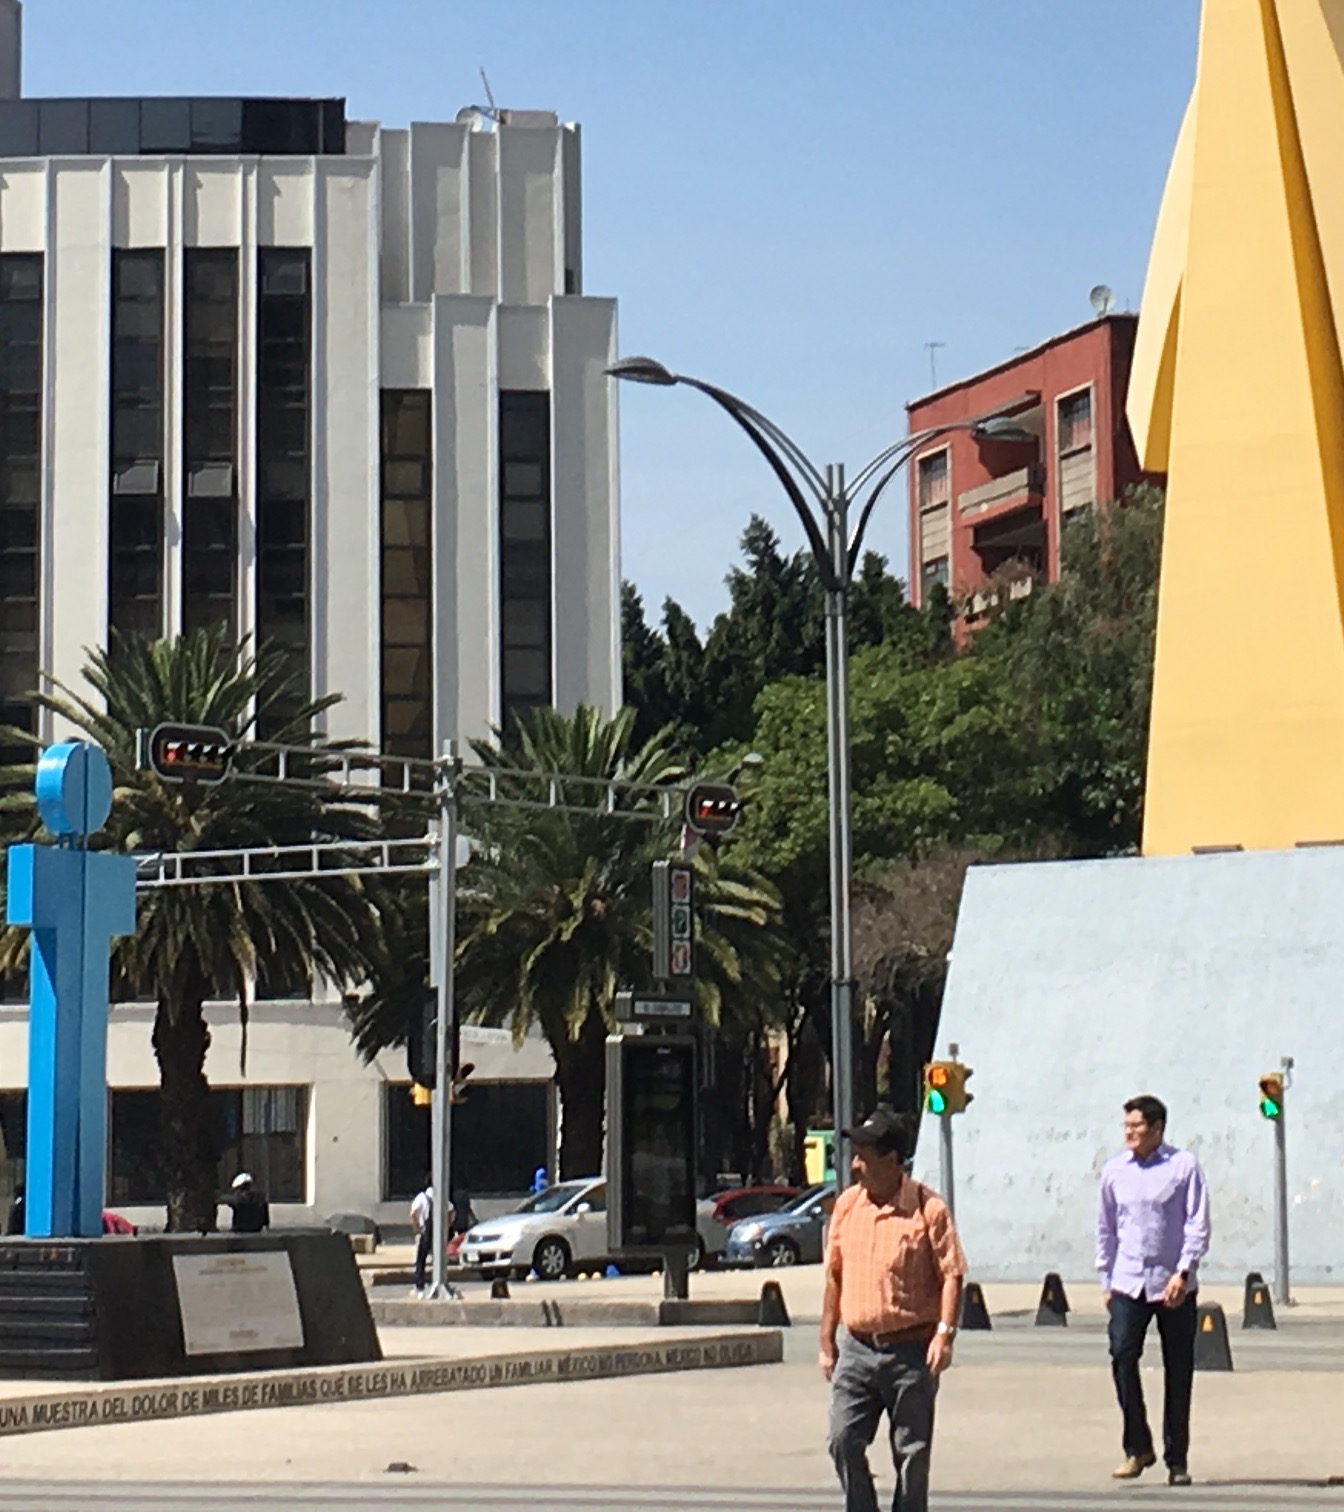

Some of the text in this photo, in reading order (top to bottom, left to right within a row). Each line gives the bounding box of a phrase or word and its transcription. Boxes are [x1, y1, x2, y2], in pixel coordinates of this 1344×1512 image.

[32, 1399, 99, 1424] MUESTRA
[102, 1396, 128, 1418] DEL
[131, 1393, 179, 1416] DOLOR
[181, 1390, 199, 1411] DE
[202, 1385, 239, 1408] MILES
[242, 1382, 259, 1405] DE
[261, 1378, 318, 1404] FAMILIAS
[365, 1371, 390, 1393] LES
[390, 1371, 406, 1391] HA
[410, 1364, 486, 1389] ARREBATADO
[489, 1363, 504, 1383] UN
